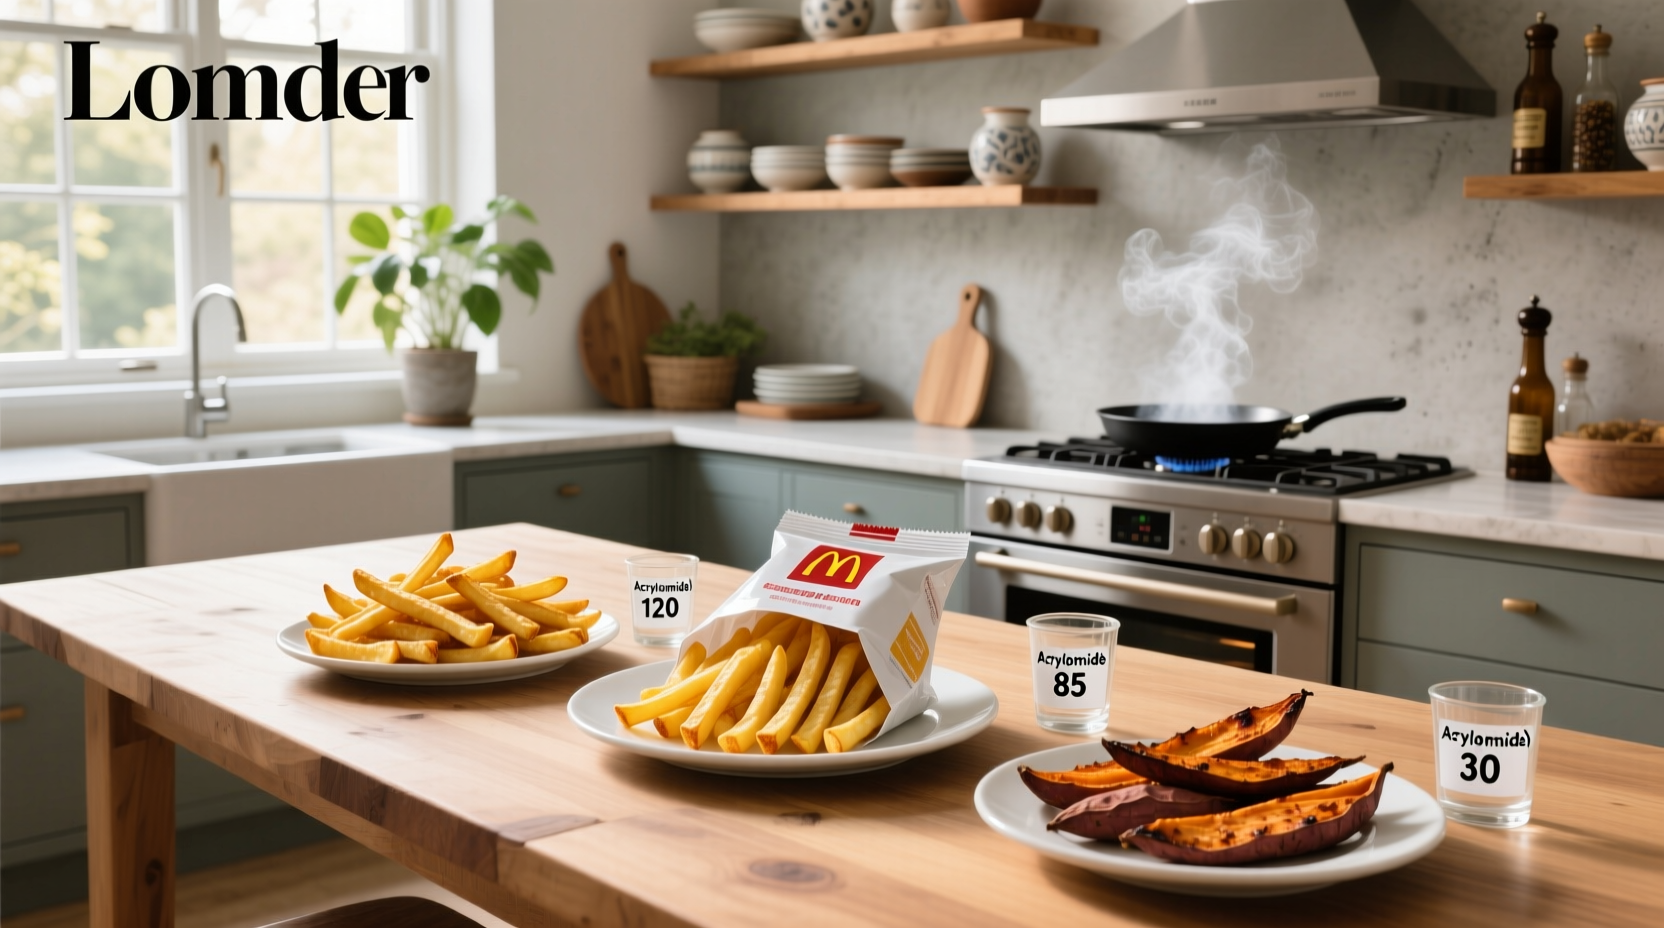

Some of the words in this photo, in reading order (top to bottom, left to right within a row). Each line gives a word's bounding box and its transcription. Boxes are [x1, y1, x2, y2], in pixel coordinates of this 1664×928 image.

[641, 597, 679, 618] 120
[1053, 671, 1087, 697] 85
[1460, 752, 1501, 784] 30
